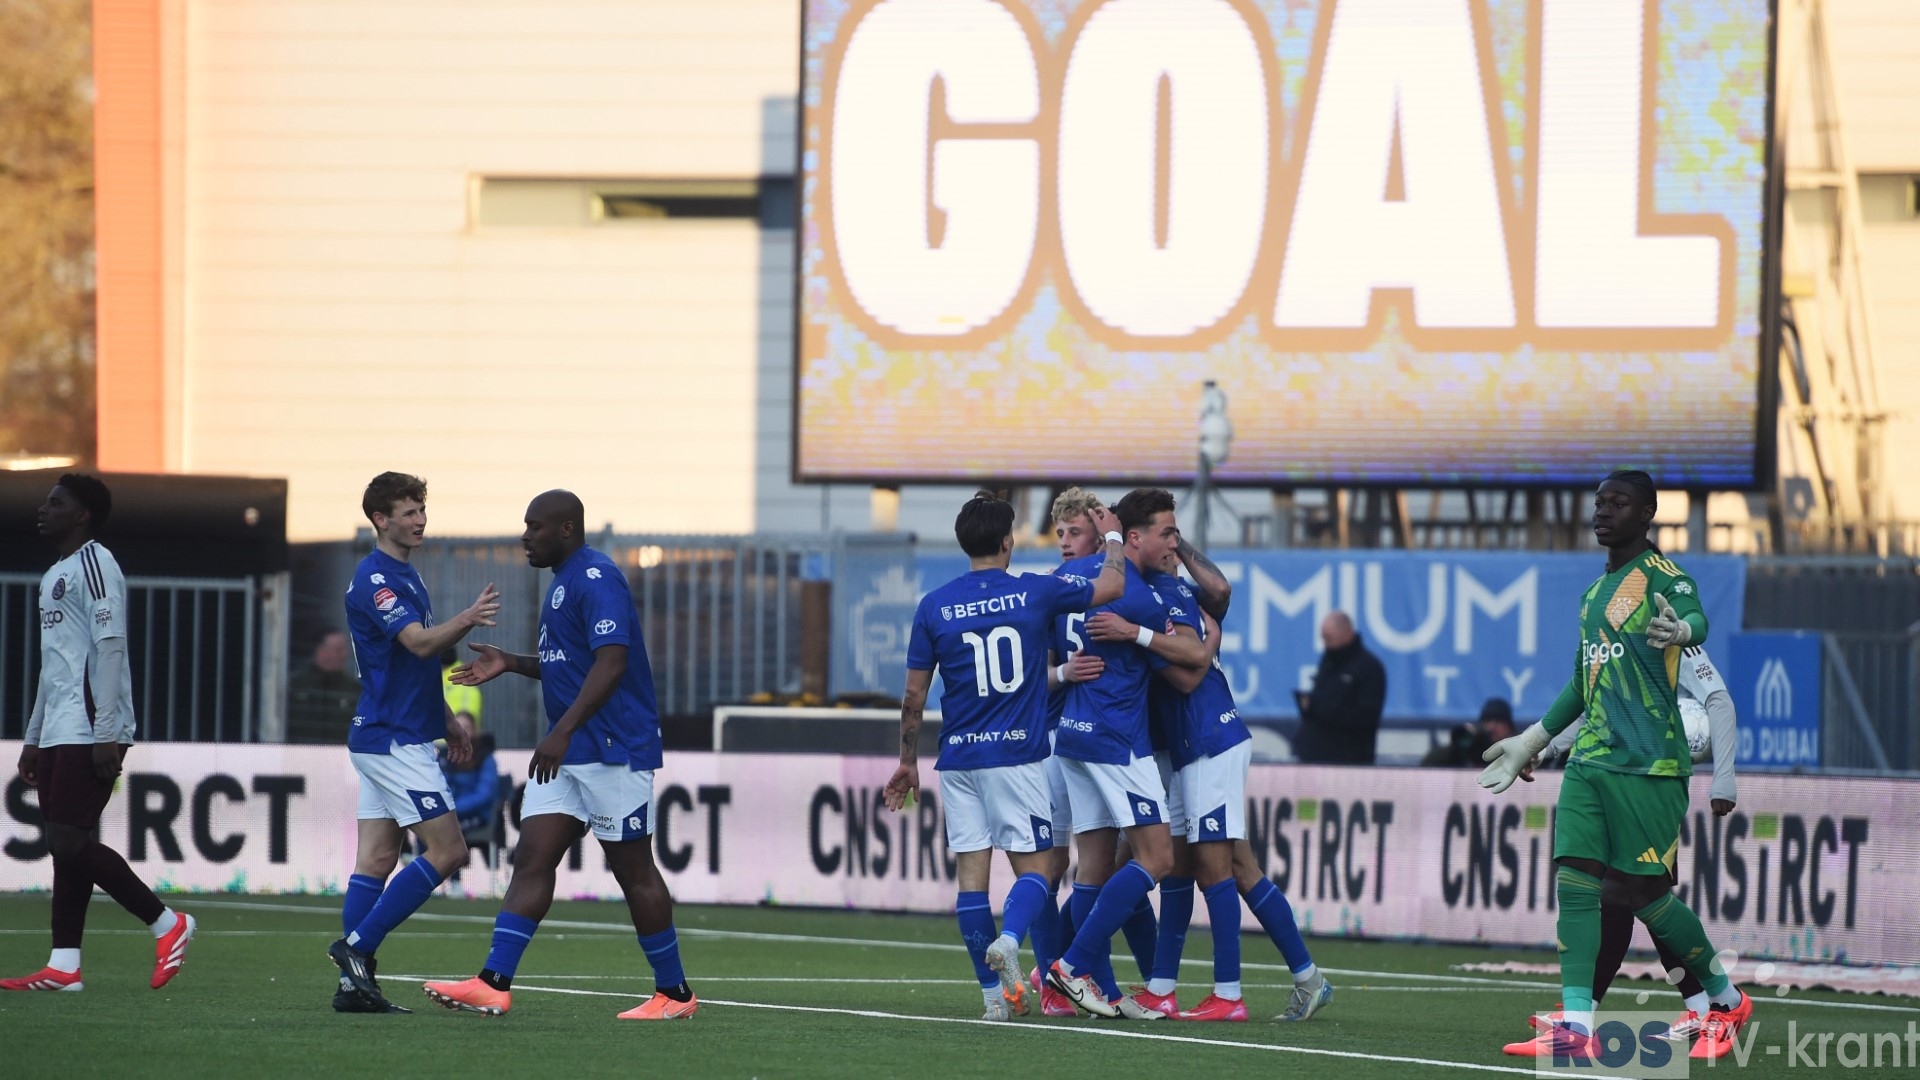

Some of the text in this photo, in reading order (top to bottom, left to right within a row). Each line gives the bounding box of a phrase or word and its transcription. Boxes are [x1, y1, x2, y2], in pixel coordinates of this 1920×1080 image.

[831, 0, 1722, 336] GOAL
[953, 591, 1027, 619] BETCITY
[961, 626, 1026, 697] 10
[966, 731, 1000, 743] THAT
[1002, 729, 1026, 741] ASS
